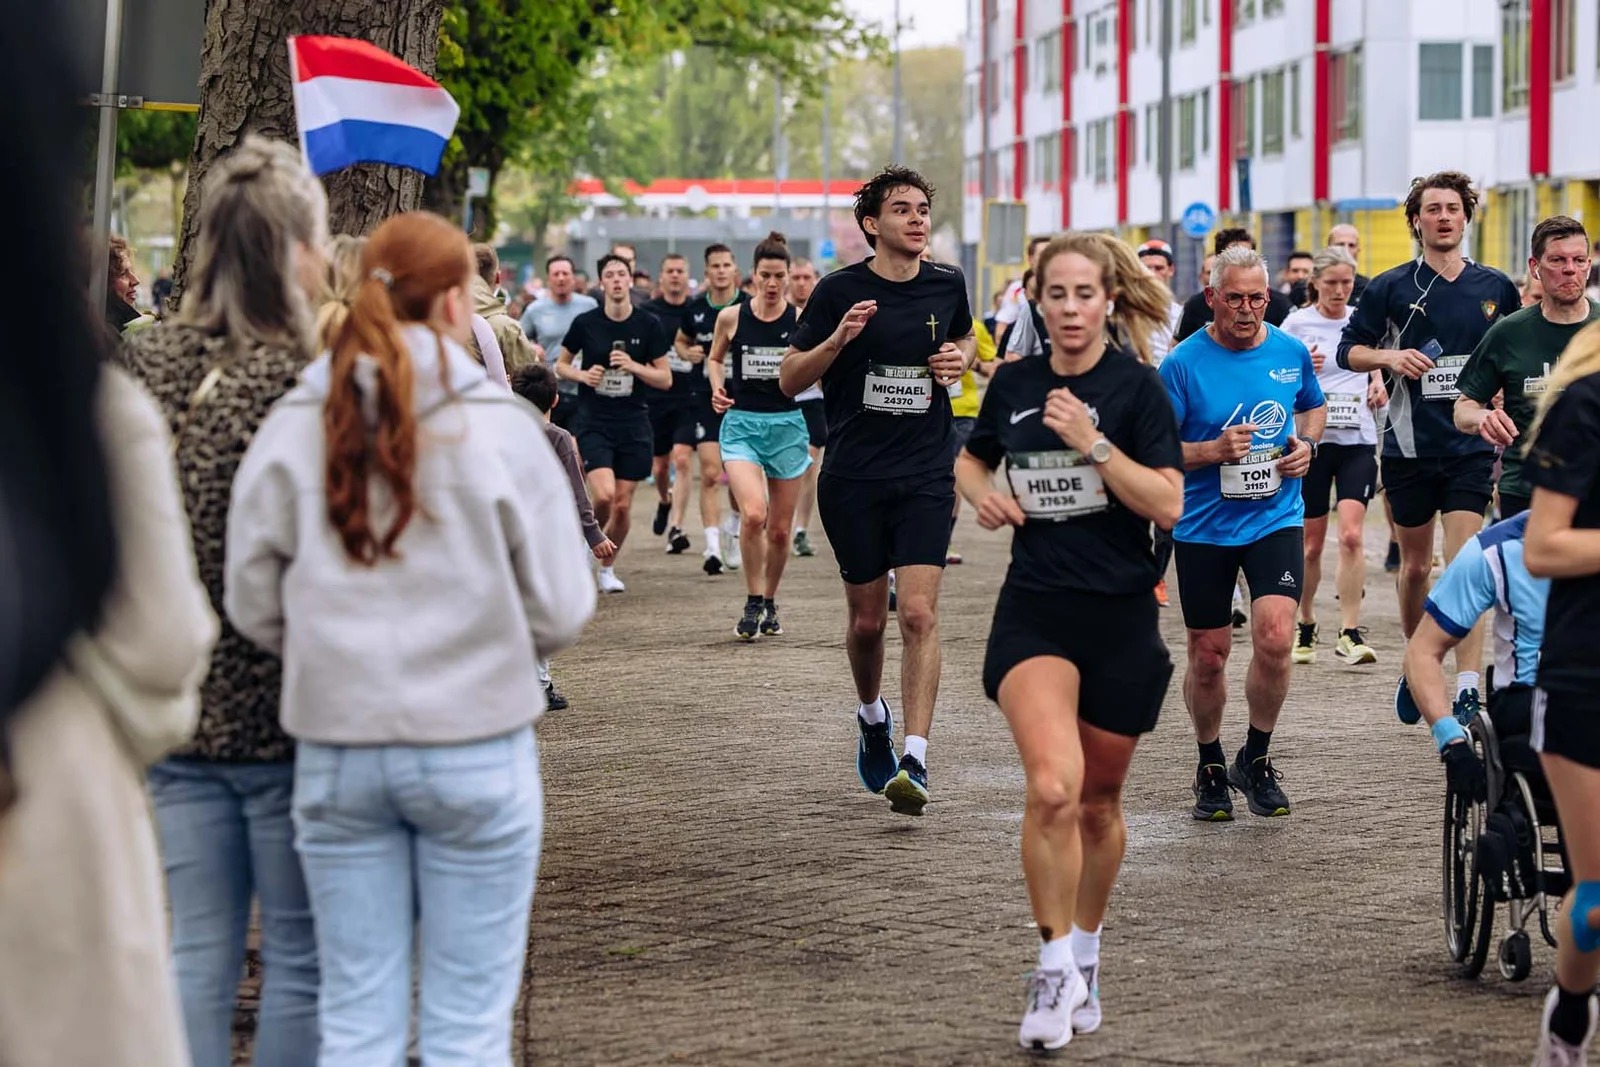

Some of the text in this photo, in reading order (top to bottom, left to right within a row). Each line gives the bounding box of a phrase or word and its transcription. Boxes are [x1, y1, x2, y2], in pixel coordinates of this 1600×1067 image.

[872, 384, 925, 395] MICHAEL
[884, 396, 913, 405] 24370
[1241, 468, 1271, 482] TON
[1027, 477, 1084, 494] HILDE
[1245, 482, 1268, 491] 31151
